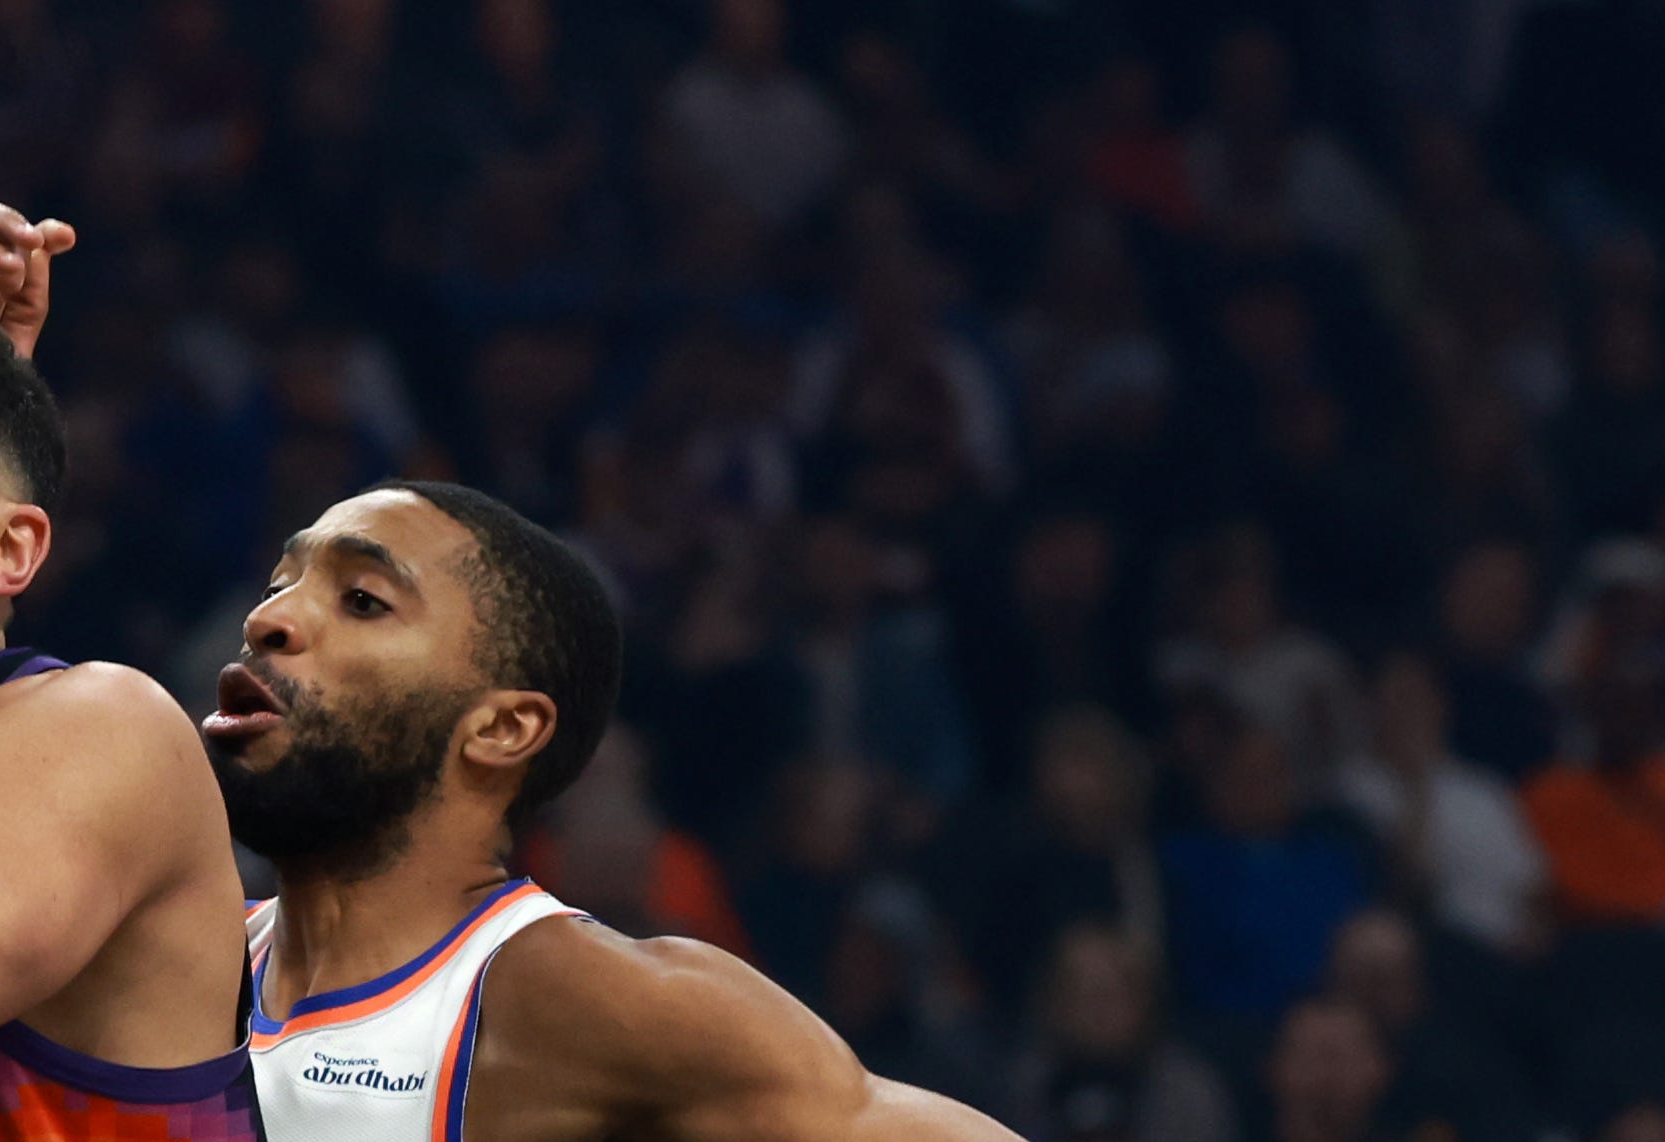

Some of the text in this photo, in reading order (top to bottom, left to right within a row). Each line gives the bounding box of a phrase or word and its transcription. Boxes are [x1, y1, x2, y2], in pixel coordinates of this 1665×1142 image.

[314, 1051, 379, 1066] experience
[303, 1066, 428, 1092] abu dhabi
